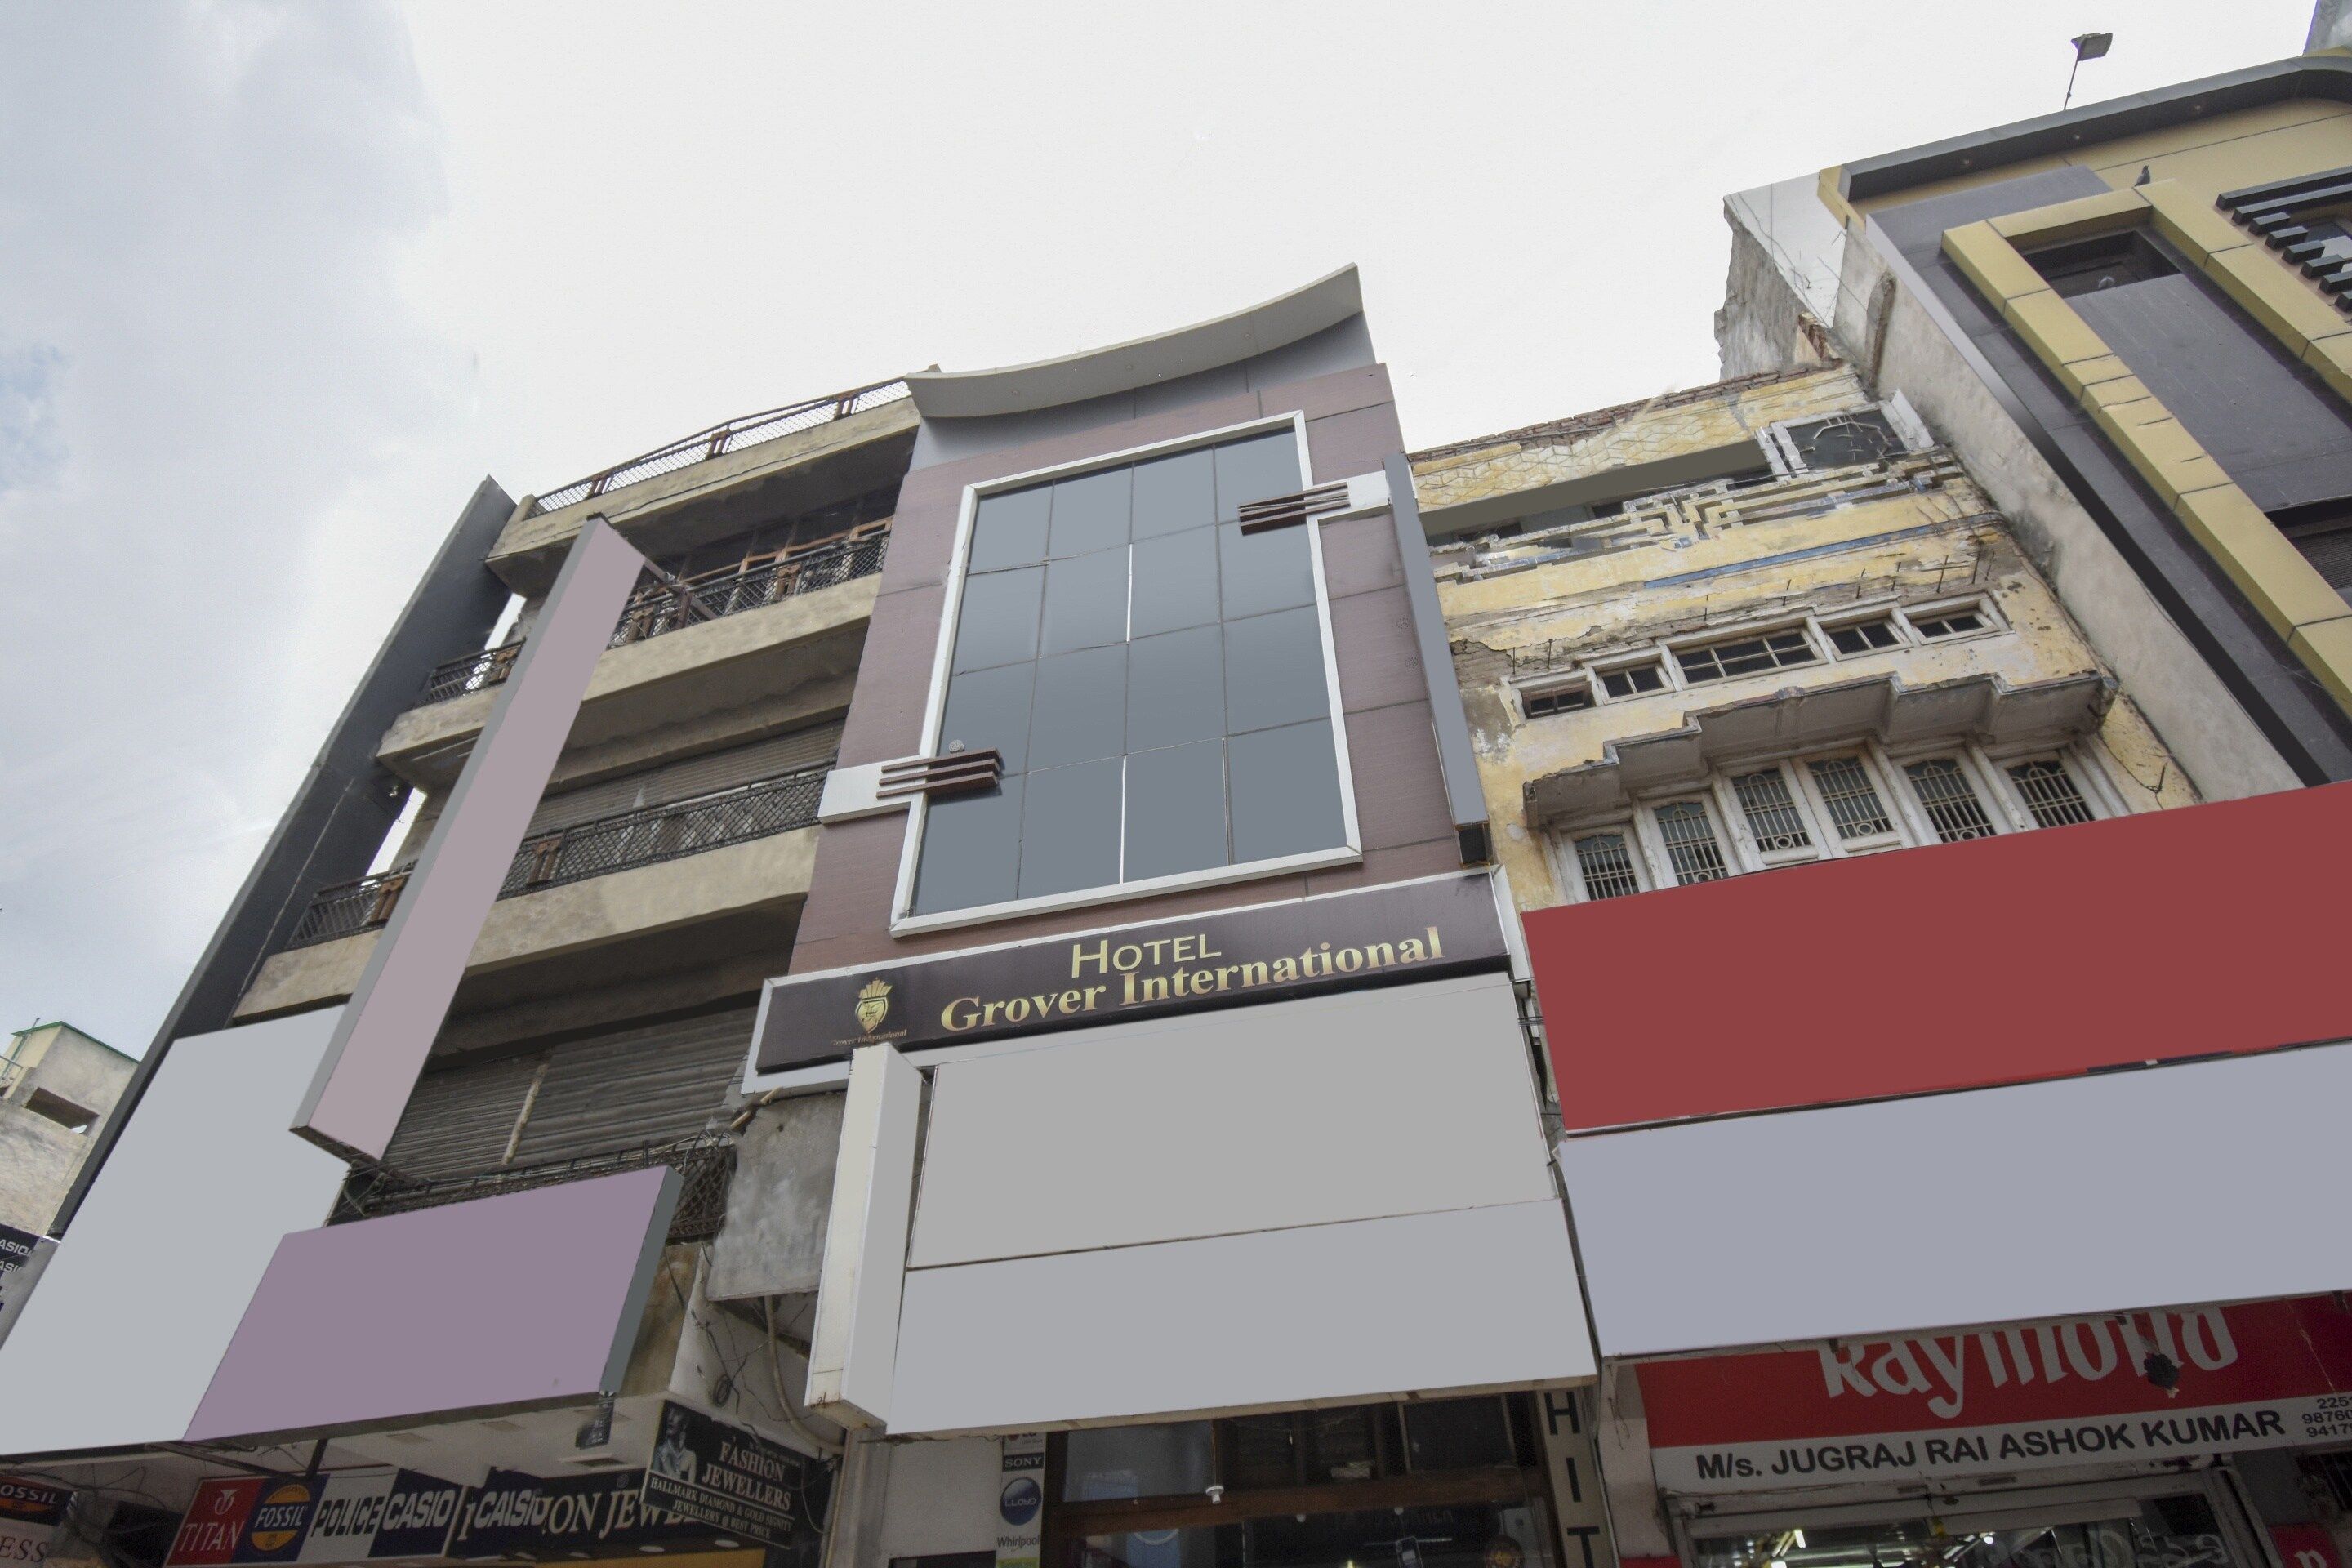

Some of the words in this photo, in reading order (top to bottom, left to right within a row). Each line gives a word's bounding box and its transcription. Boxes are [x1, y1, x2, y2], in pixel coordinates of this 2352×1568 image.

[1071, 933, 1222, 978] HOTEL
[940, 983, 1106, 1031] Grover
[1118, 926, 1446, 1007] International
[719, 1441, 786, 1483] FASHION
[1005, 1456, 1042, 1468] SONY
[1696, 1452, 1762, 1479] M/s.
[1771, 1441, 1917, 1475] JUGRAJ
[1924, 1436, 1989, 1465] RAI
[1999, 1423, 2136, 1459] ASHOK
[2141, 1410, 2286, 1447] KUMAR
[650, 1477, 697, 1503] HALLMARK
[699, 1492, 736, 1514] DIAMOND
[744, 1507, 765, 1523] GOLD
[702, 1463, 791, 1512] JEWELLERS
[1004, 1497, 1036, 1508] LLOYD
[254, 1505, 305, 1529] FOSSIL
[311, 1496, 385, 1537] POLICE
[381, 1488, 456, 1531] CASIO
[672, 1499, 720, 1524] JEWELLERY
[180, 1520, 245, 1552] TITAN
[997, 1535, 1040, 1548] Whirlpool
